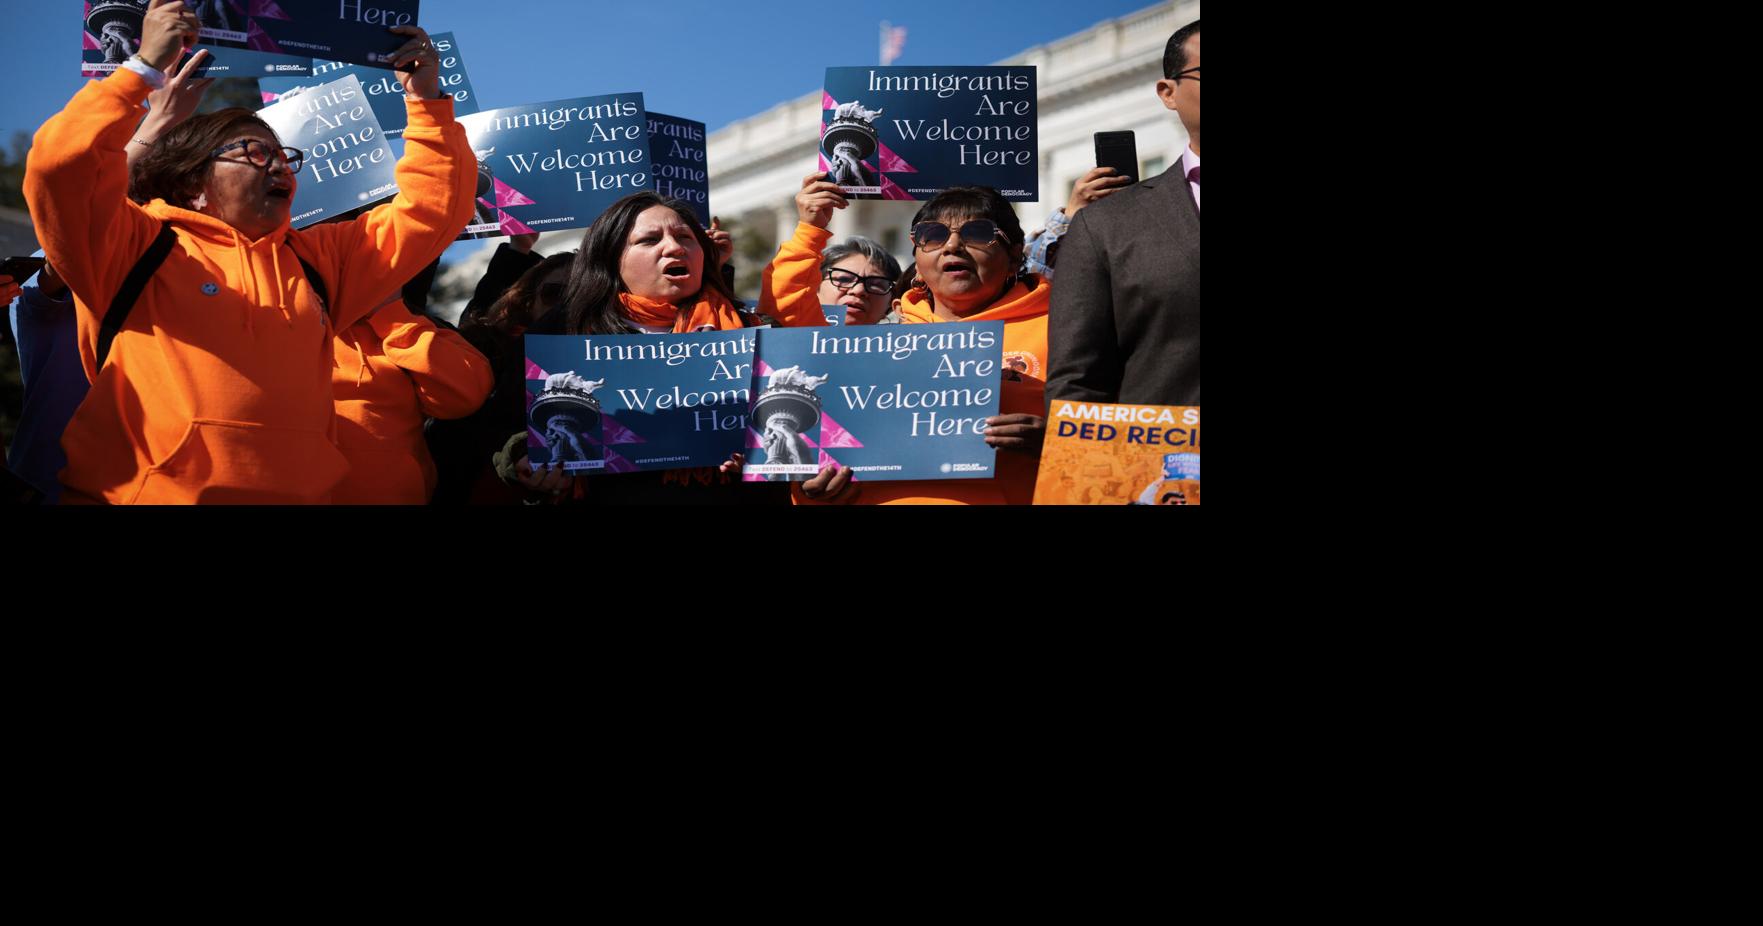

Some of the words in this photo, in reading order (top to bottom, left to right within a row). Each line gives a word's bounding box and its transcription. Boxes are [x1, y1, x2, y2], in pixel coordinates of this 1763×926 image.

[339, 0, 411, 27] Here
[868, 70, 1029, 99] Immigrants
[486, 98, 637, 132] mmigrants
[975, 95, 1030, 116] Are
[315, 106, 365, 134] Are
[647, 119, 703, 142] grants
[893, 118, 1030, 141] Welcome
[300, 126, 375, 164] come
[587, 122, 640, 144] Are
[506, 148, 643, 174] Welcome
[668, 139, 704, 162] Are
[959, 144, 1031, 166] Here
[310, 147, 385, 183] Here
[650, 163, 705, 183] come
[575, 170, 647, 192] Here
[656, 179, 706, 203] Here
[811, 325, 995, 360] Immigrants
[709, 360, 749, 381] Ar
[932, 354, 993, 379] Are
[616, 386, 749, 410] Welcom
[840, 383, 991, 410] Welcome
[694, 410, 749, 432] Her
[1056, 403, 1175, 424] AMERICA
[1057, 421, 1117, 441] DED
[1127, 426, 1200, 446] RECI
